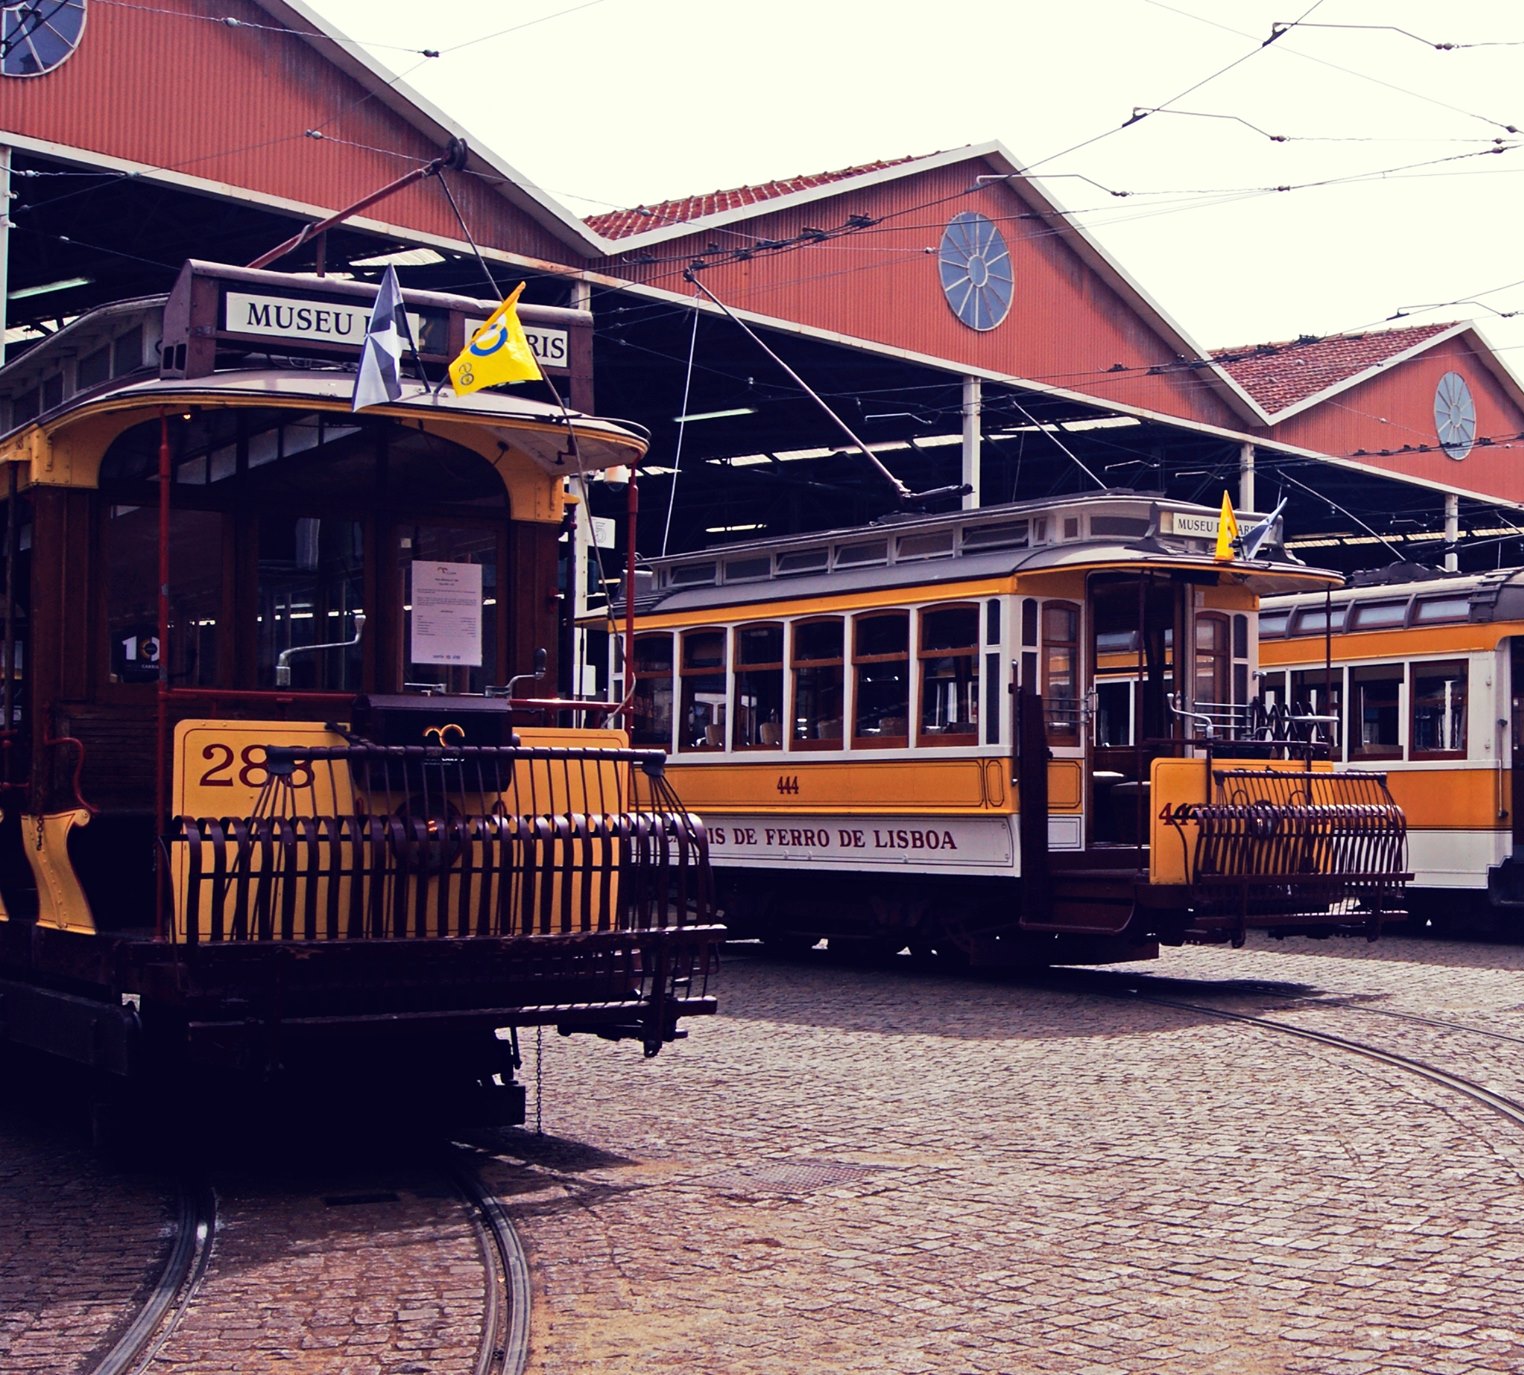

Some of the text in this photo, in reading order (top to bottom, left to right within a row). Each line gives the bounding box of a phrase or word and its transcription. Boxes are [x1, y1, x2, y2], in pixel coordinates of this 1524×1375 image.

[246, 302, 353, 335] MUSEU
[1177, 519, 1213, 533] MUSEU
[776, 776, 799, 795] 444
[733, 827, 758, 845] DE
[765, 828, 830, 848] FERRO
[838, 829, 866, 848] DE
[873, 830, 958, 850] LISBOA
